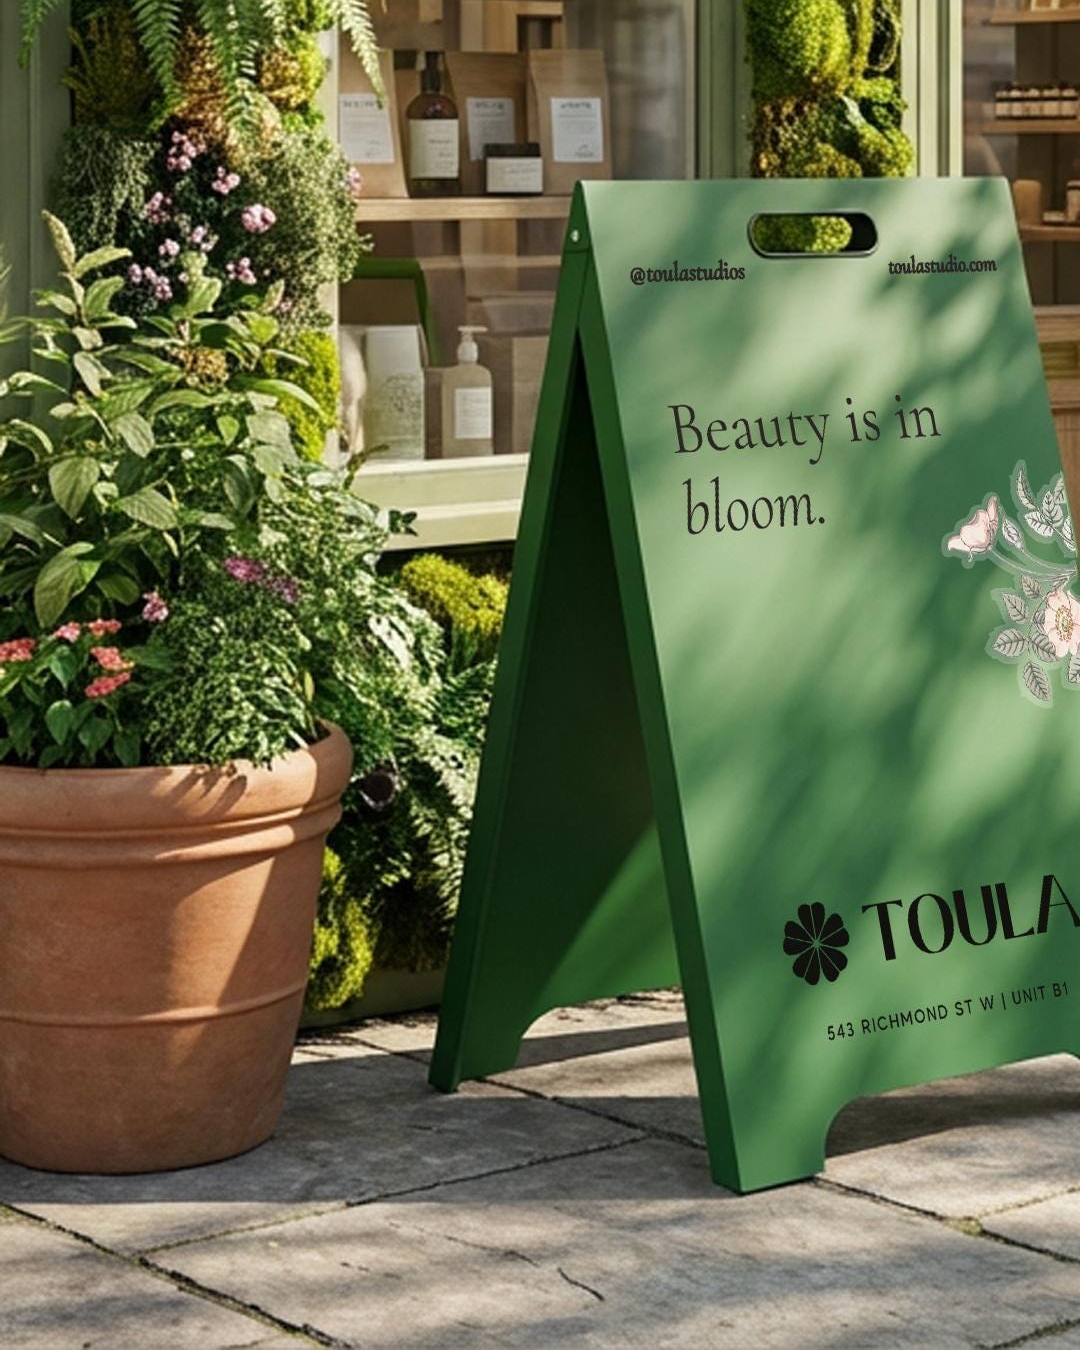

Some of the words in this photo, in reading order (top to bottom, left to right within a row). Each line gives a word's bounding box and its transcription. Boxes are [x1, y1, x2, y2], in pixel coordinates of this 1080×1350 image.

[630, 258, 746, 286] @toulastudios
[888, 254, 998, 275] toulastudio.com
[667, 404, 830, 466] Beauty
[845, 397, 882, 443] is
[895, 394, 942, 441] in
[682, 478, 826, 536] bloom.
[827, 1021, 855, 1041] 543
[861, 1004, 949, 1035] RICHMOND
[954, 999, 973, 1017] ST
[978, 994, 995, 1011] W
[1011, 985, 1046, 1006] UNIT
[1052, 980, 1069, 998] B1
